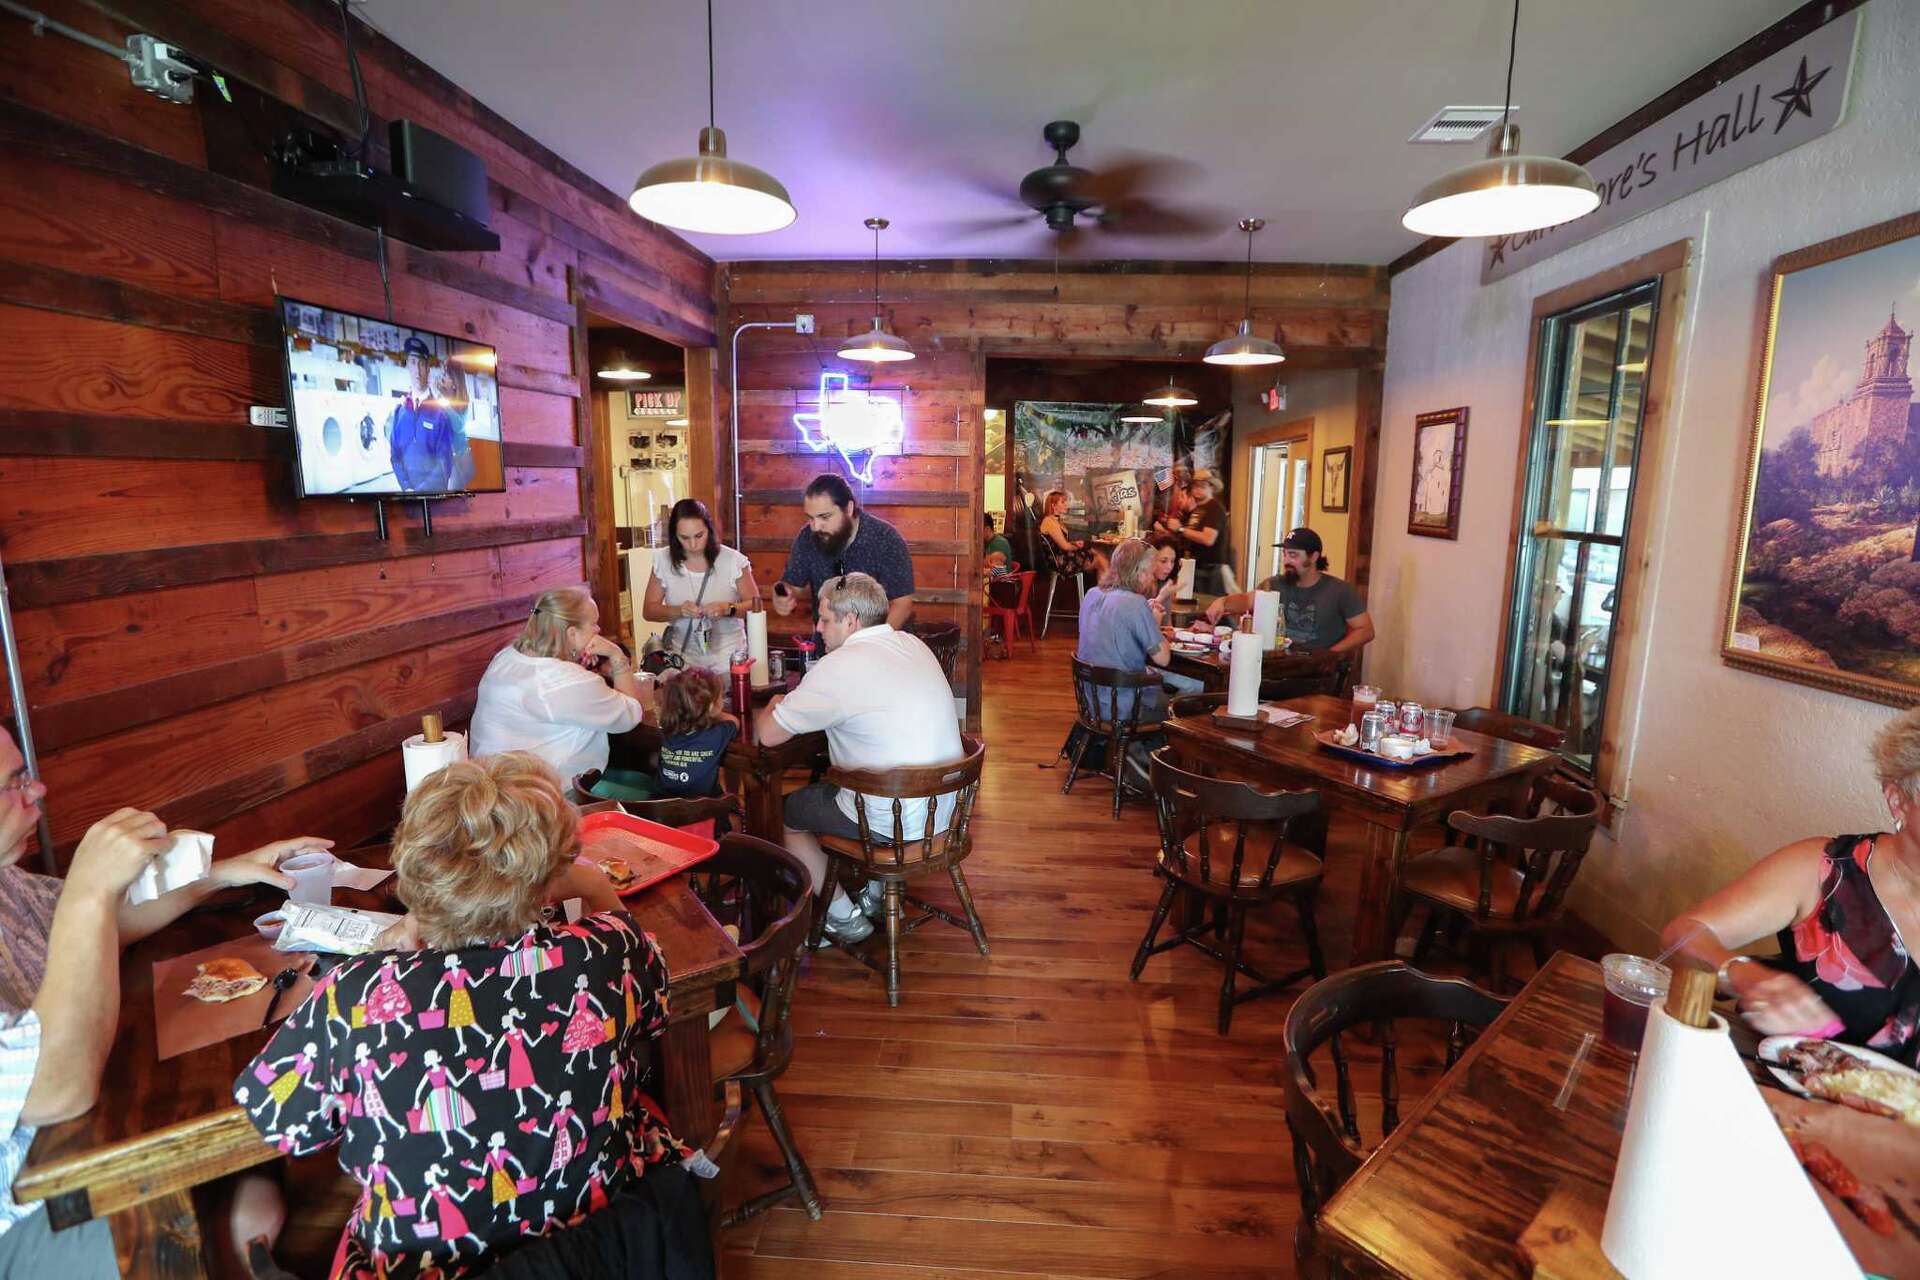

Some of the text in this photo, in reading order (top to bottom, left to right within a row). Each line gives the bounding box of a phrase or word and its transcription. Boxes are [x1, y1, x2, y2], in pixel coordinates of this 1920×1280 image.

[1673, 83, 1765, 172] Hall
[635, 391, 682, 408] PICK UP
